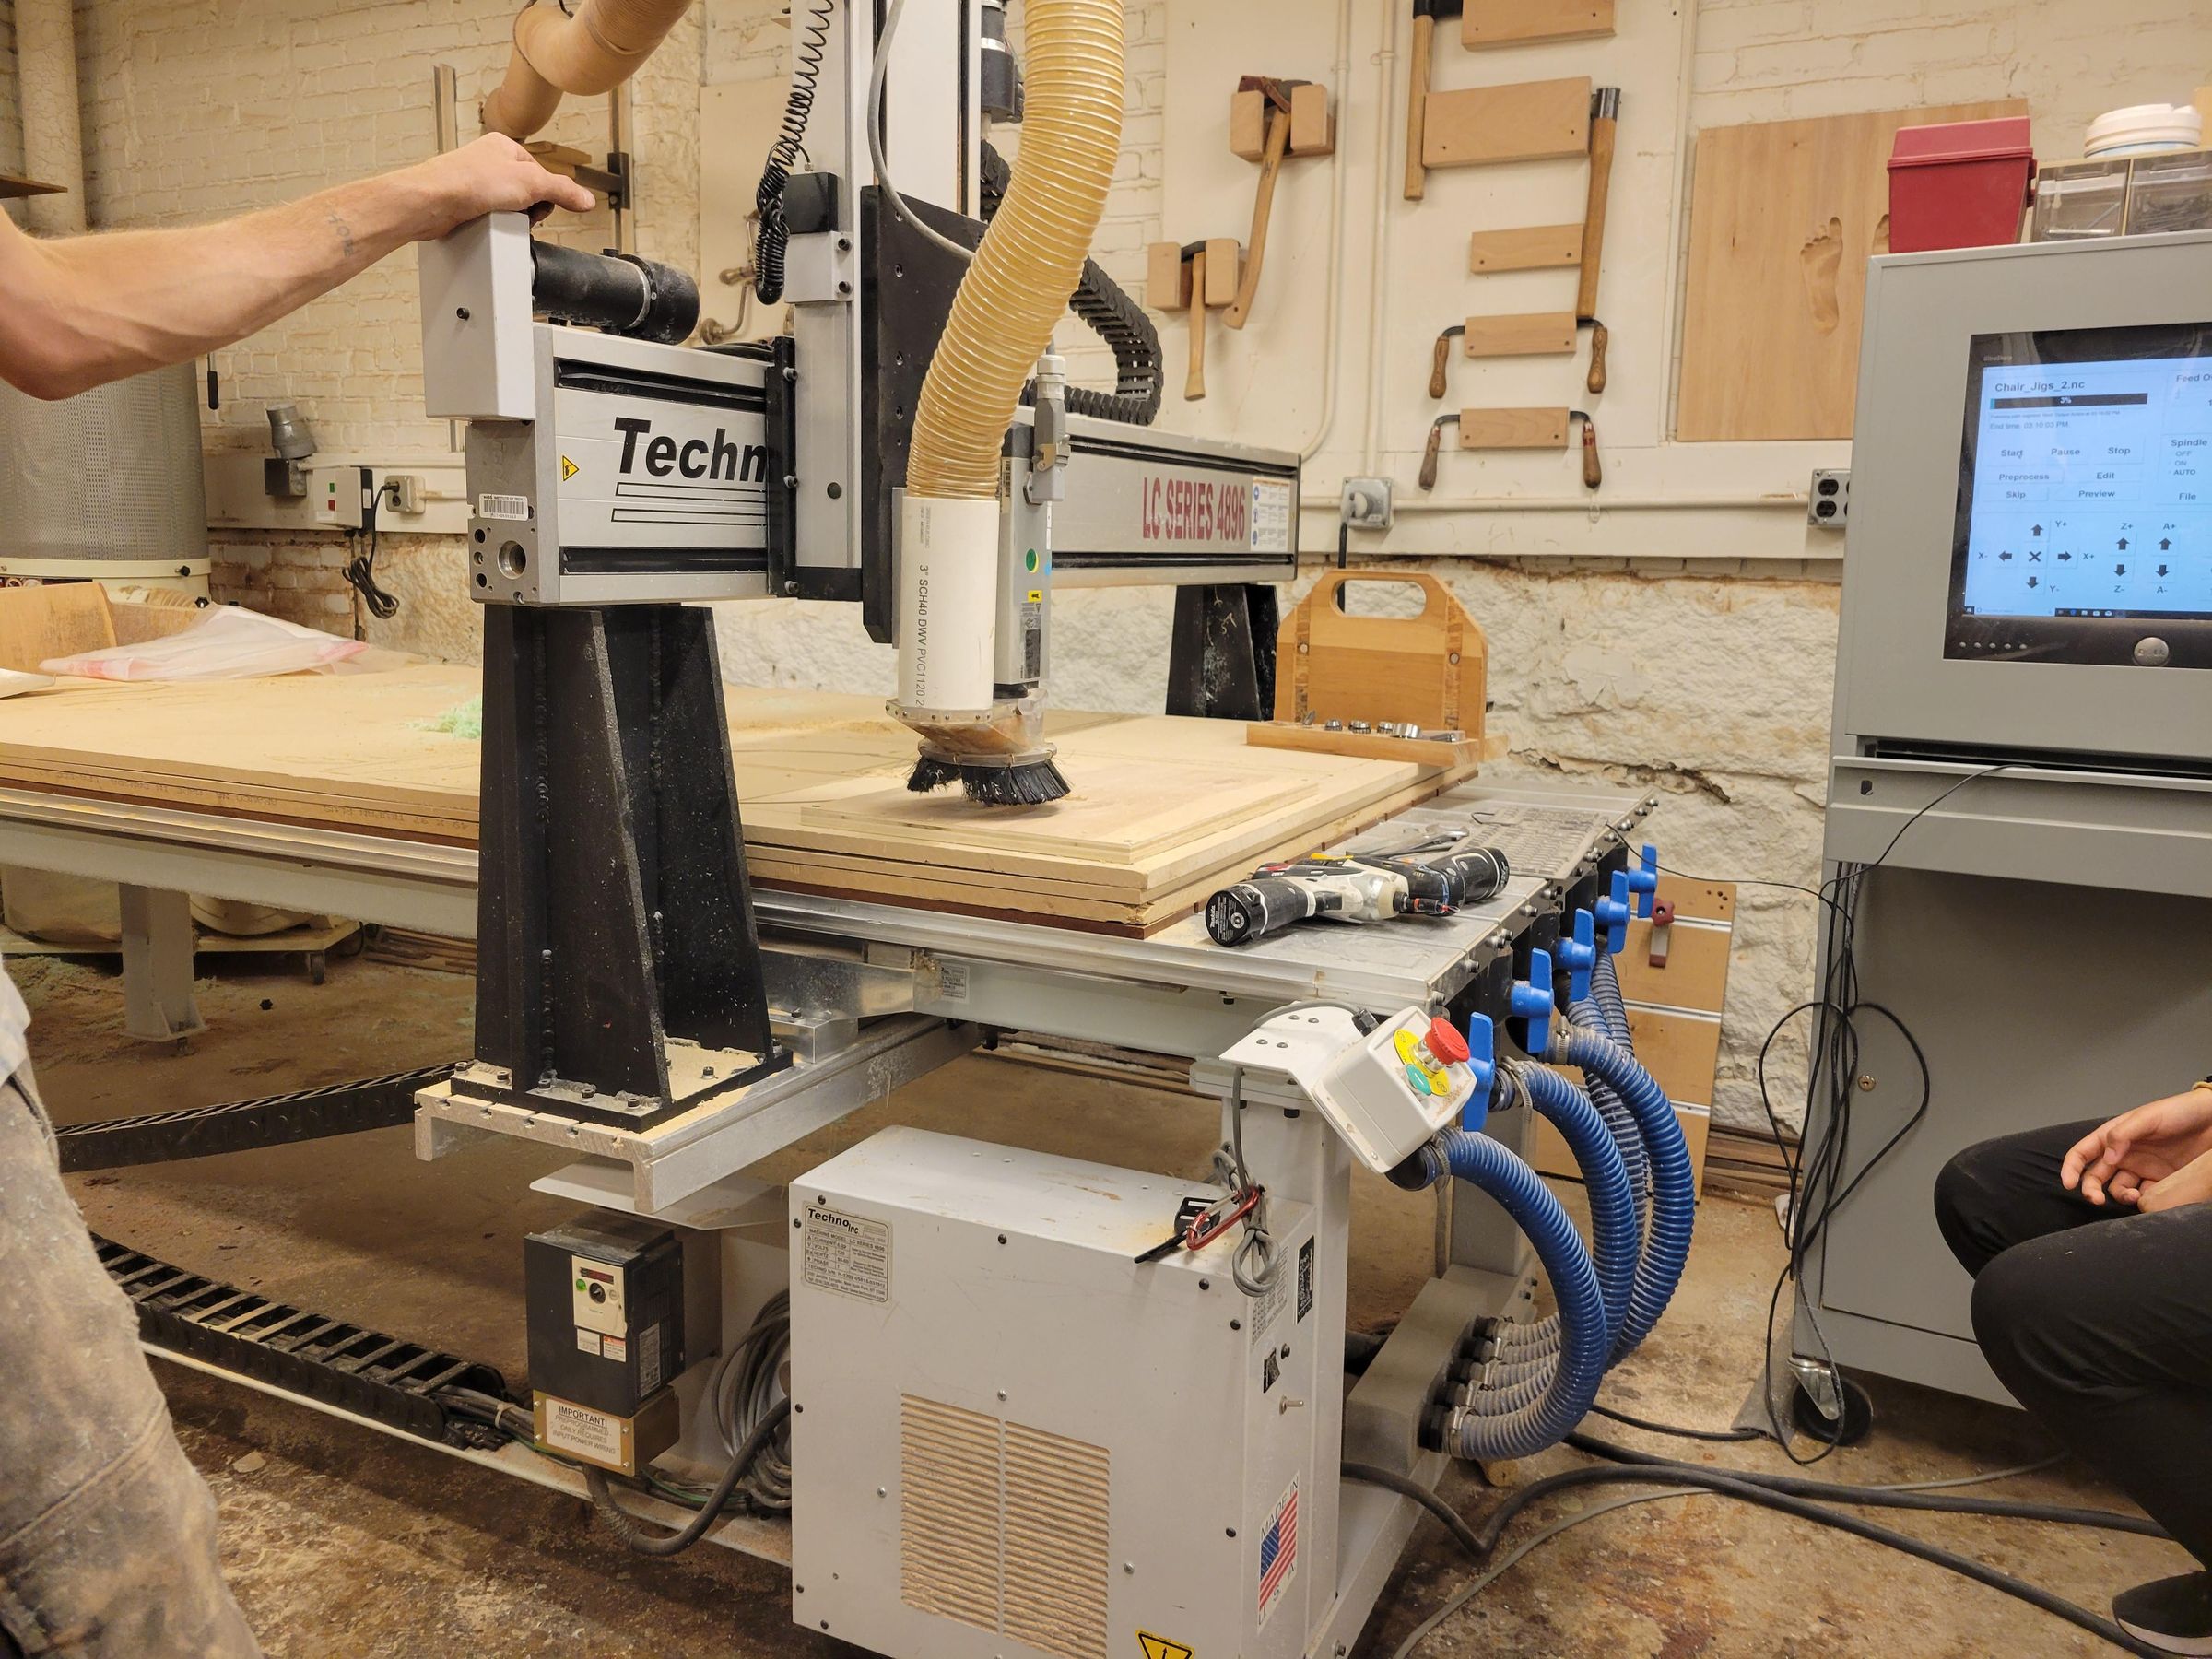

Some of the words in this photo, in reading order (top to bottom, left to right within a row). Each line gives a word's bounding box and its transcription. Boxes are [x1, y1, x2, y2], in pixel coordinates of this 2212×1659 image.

[2176, 373, 2200, 382] Feed
[1994, 381, 2086, 394] Chair_Jigs_2.nc
[2171, 439, 2208, 448] Spindle
[613, 416, 767, 484] Techn
[2000, 449, 2023, 457] Start
[2051, 448, 2080, 456] Pause
[2108, 446, 2131, 456] Stop
[1998, 473, 2050, 481] Preprocess
[2096, 471, 2115, 480] Edit
[2006, 490, 2026, 500] Skip
[2078, 489, 2116, 498] Preview
[2179, 492, 2197, 500] File
[1142, 477, 1161, 540] LC
[1165, 478, 1214, 541] SERIES
[1217, 483, 1245, 541] 4896
[918, 579, 929, 616] SCH40
[917, 618, 927, 646] DWV
[915, 648, 926, 697] PVC1120
[807, 1208, 850, 1228] Techno
